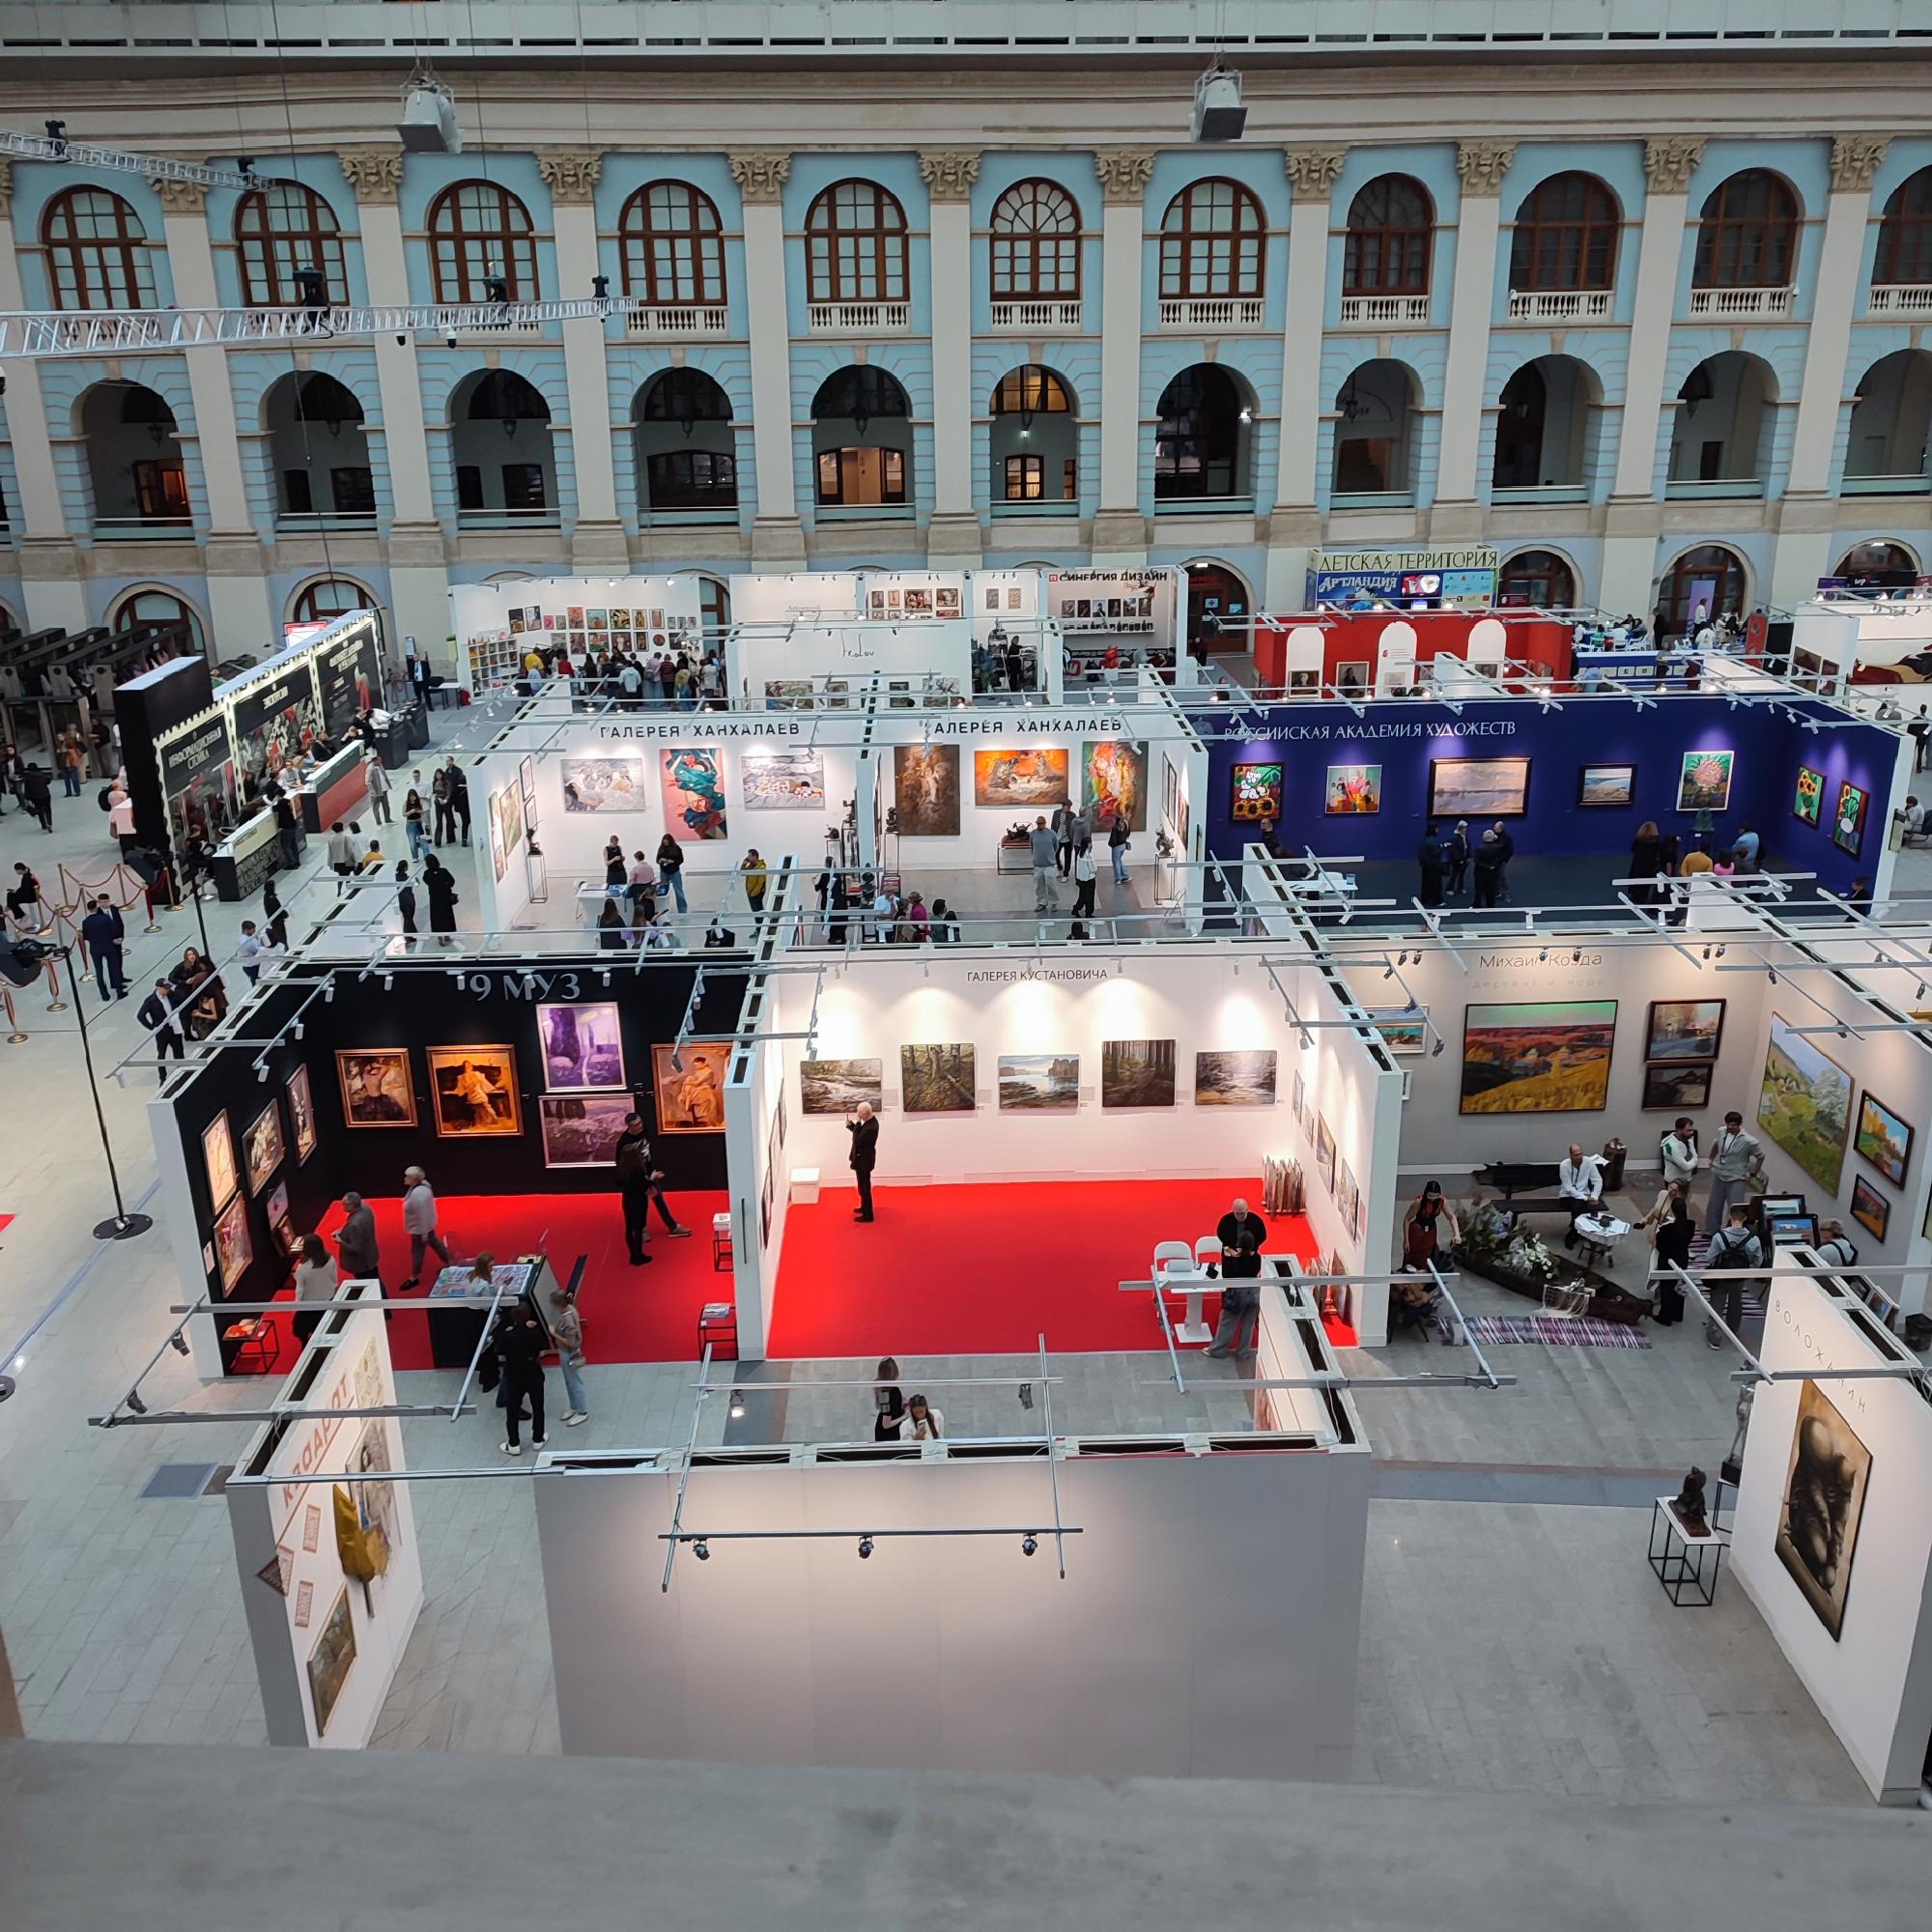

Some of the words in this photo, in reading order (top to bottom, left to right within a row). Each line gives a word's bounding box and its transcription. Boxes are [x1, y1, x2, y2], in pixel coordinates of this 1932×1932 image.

[1319, 554, 1392, 572] ДЕТСКАЯ
[1399, 552, 1497, 569] ТЕРРИТОРИЯ
[1059, 571, 1117, 582] СИНЕРГИЯ
[1121, 570, 1168, 582] ДИЗАЙН
[600, 725, 679, 738] ГАЛЕРЕЯ
[693, 724, 800, 736] ХАНХАЛАЕВ
[1016, 720, 1122, 732] ХАНХАЛАЕВ
[1334, 724, 1422, 740] АКАДЕМИЯ
[1426, 722, 1516, 736] ХУДОЖЕСТВ
[1480, 954, 1544, 968] Михаил
[967, 971, 1017, 981] ГАЛЕРЕЯ
[1020, 969, 1108, 981] КУСТАНОВИЧА
[469, 974, 492, 1001] 9
